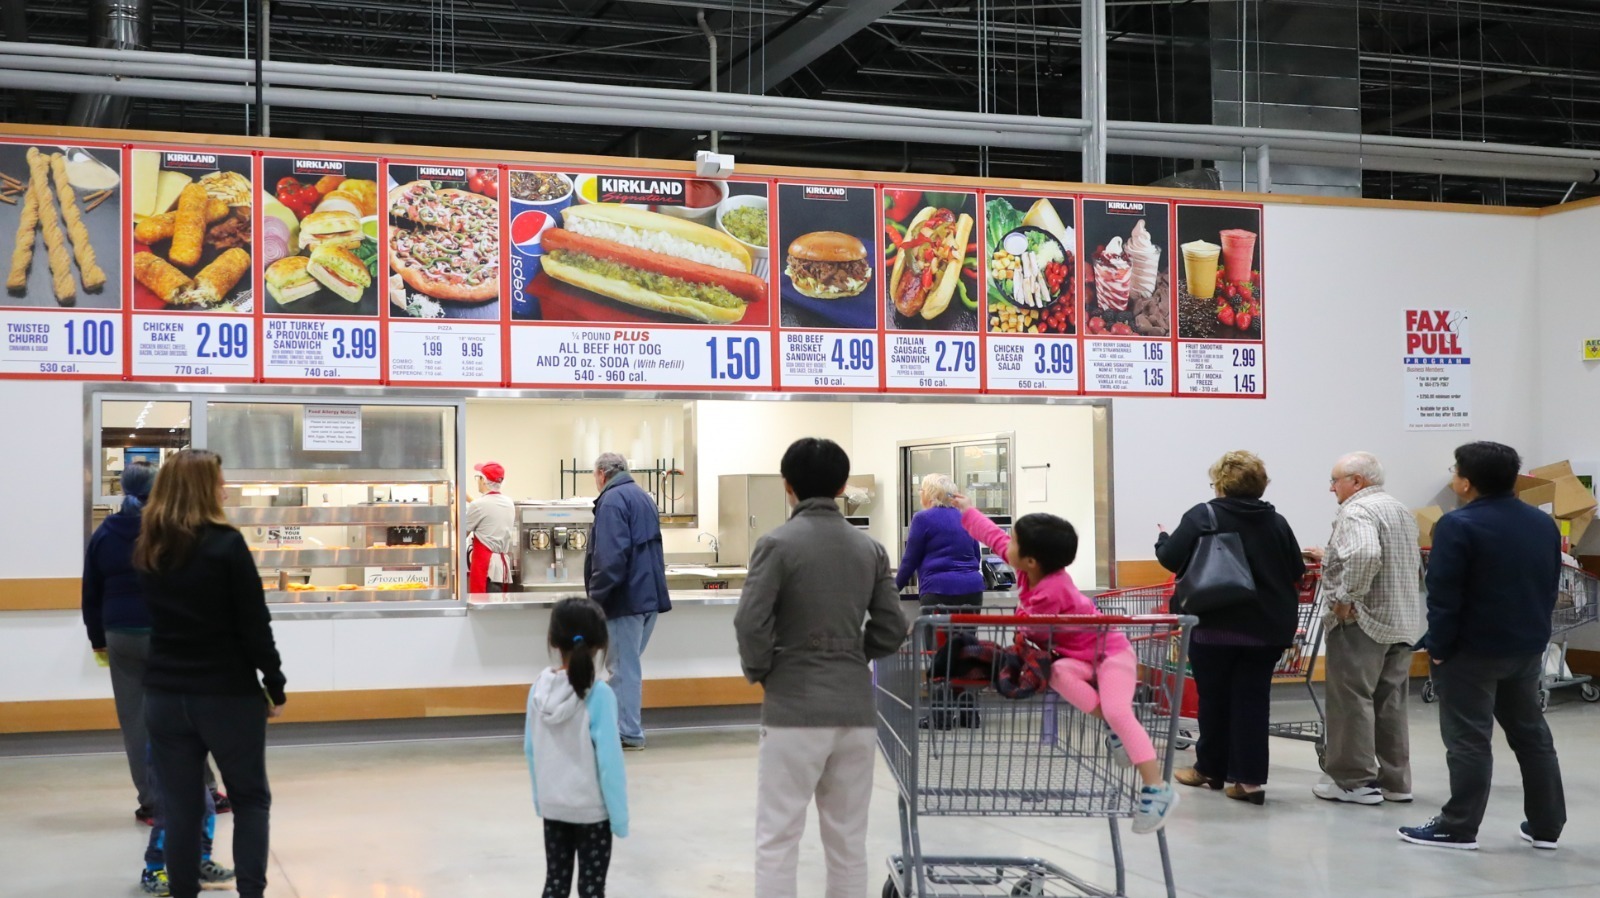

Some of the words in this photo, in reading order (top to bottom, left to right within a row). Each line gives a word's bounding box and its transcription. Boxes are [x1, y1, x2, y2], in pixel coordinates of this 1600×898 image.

[167, 154, 215, 163] KIRKLAND
[296, 160, 342, 169] KIRKLAND
[420, 167, 464, 176] KIRKLAND
[602, 179, 682, 194] KIRKLAND
[806, 187, 844, 195] KIRKLAND
[602, 192, 682, 204] Signature
[1109, 202, 1143, 210] KIRKLAND
[511, 255, 526, 303] pepsi
[269, 321, 287, 330] HOT
[290, 321, 324, 330] TURKEY
[1406, 310, 1450, 332] FAX
[7, 323, 50, 333] TWISTED
[143, 322, 184, 332] CHICKEN
[9, 334, 48, 343] CHURRO
[64, 320, 114, 355] 1.00
[151, 333, 176, 342] BAKE
[197, 322, 247, 358] 2.99
[266, 330, 272, 339] &
[276, 331, 328, 340] PROVOLONE
[582, 332, 611, 340] POUND
[614, 331, 650, 341] PLUS
[788, 335, 803, 343] BBQ
[274, 340, 321, 349] SANDWICH
[333, 328, 376, 358] 3.99
[790, 344, 821, 352] BRISKET
[1407, 333, 1462, 355] PULL
[423, 342, 442, 356] 1.99
[462, 342, 483, 357] 9.95
[559, 343, 579, 354] ALL
[584, 343, 609, 354] BEEF
[614, 344, 635, 354] HOT
[639, 344, 661, 355] DOG
[894, 346, 926, 354] SAUSAGE
[994, 345, 1024, 353] CHICKEN
[1143, 343, 1163, 360] 1.65
[706, 337, 760, 380] 1.50
[786, 353, 826, 361] SANDWICH
[831, 339, 873, 370] 4.99
[891, 355, 930, 363] SANDWICH
[935, 341, 975, 372] 2.79
[1035, 343, 1073, 374] 3.99
[1233, 348, 1255, 367] 2.99
[40, 363, 58, 372] 530
[61, 364, 79, 372] cal.
[537, 356, 559, 366] AND
[564, 356, 577, 367] 20
[581, 358, 595, 367] oz.
[600, 357, 630, 368] SODA
[634, 359, 656, 369] (With
[659, 360, 684, 370] Refill)
[175, 366, 192, 374] 770
[195, 366, 212, 375] cal.
[304, 368, 320, 377] 740
[323, 368, 340, 377] cal.
[575, 370, 594, 380] 540
[606, 371, 625, 381] 960
[629, 371, 647, 382] cal.
[815, 377, 828, 385] 610
[1144, 368, 1163, 386] 1.35
[1234, 374, 1255, 392] 1.45
[368, 574, 403, 584] Frozen
